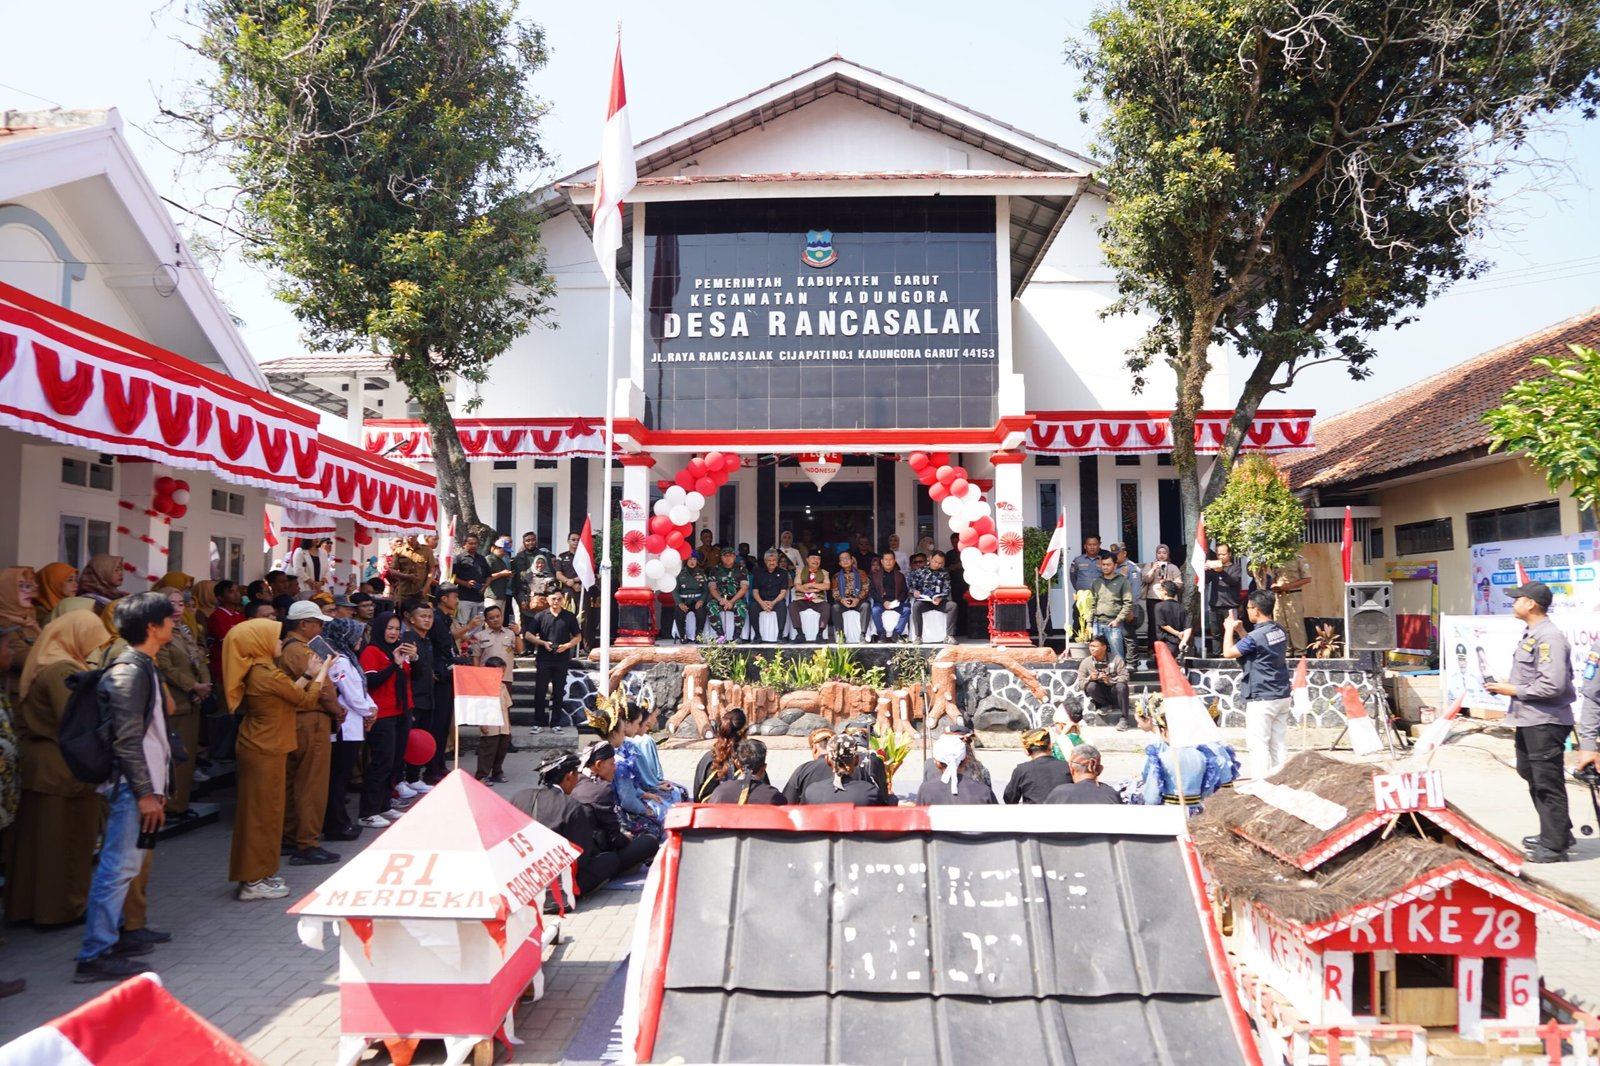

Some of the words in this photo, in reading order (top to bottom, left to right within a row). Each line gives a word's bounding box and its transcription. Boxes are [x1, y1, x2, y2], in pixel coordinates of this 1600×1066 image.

[695, 277, 782, 289] PEMERINTAH
[797, 275, 879, 287] KABUPATEN
[894, 275, 939, 286] GARUT
[690, 291, 808, 307] KECAMATAN
[828, 290, 949, 304] KADUNGORA
[664, 312, 751, 338] DESA
[768, 308, 981, 336] RANCASALAK
[698, 350, 774, 362] RANCASALAK
[858, 349, 922, 359] KADUNGORA
[924, 348, 960, 359] GARUT
[962, 348, 995, 359] 44153
[508, 832, 534, 858] DS
[376, 853, 439, 885] RI
[506, 845, 575, 905] RANCASALAK
[326, 889, 485, 908] MERDEKA
[1408, 904, 1462, 944] KE
[1472, 907, 1521, 950] 78
